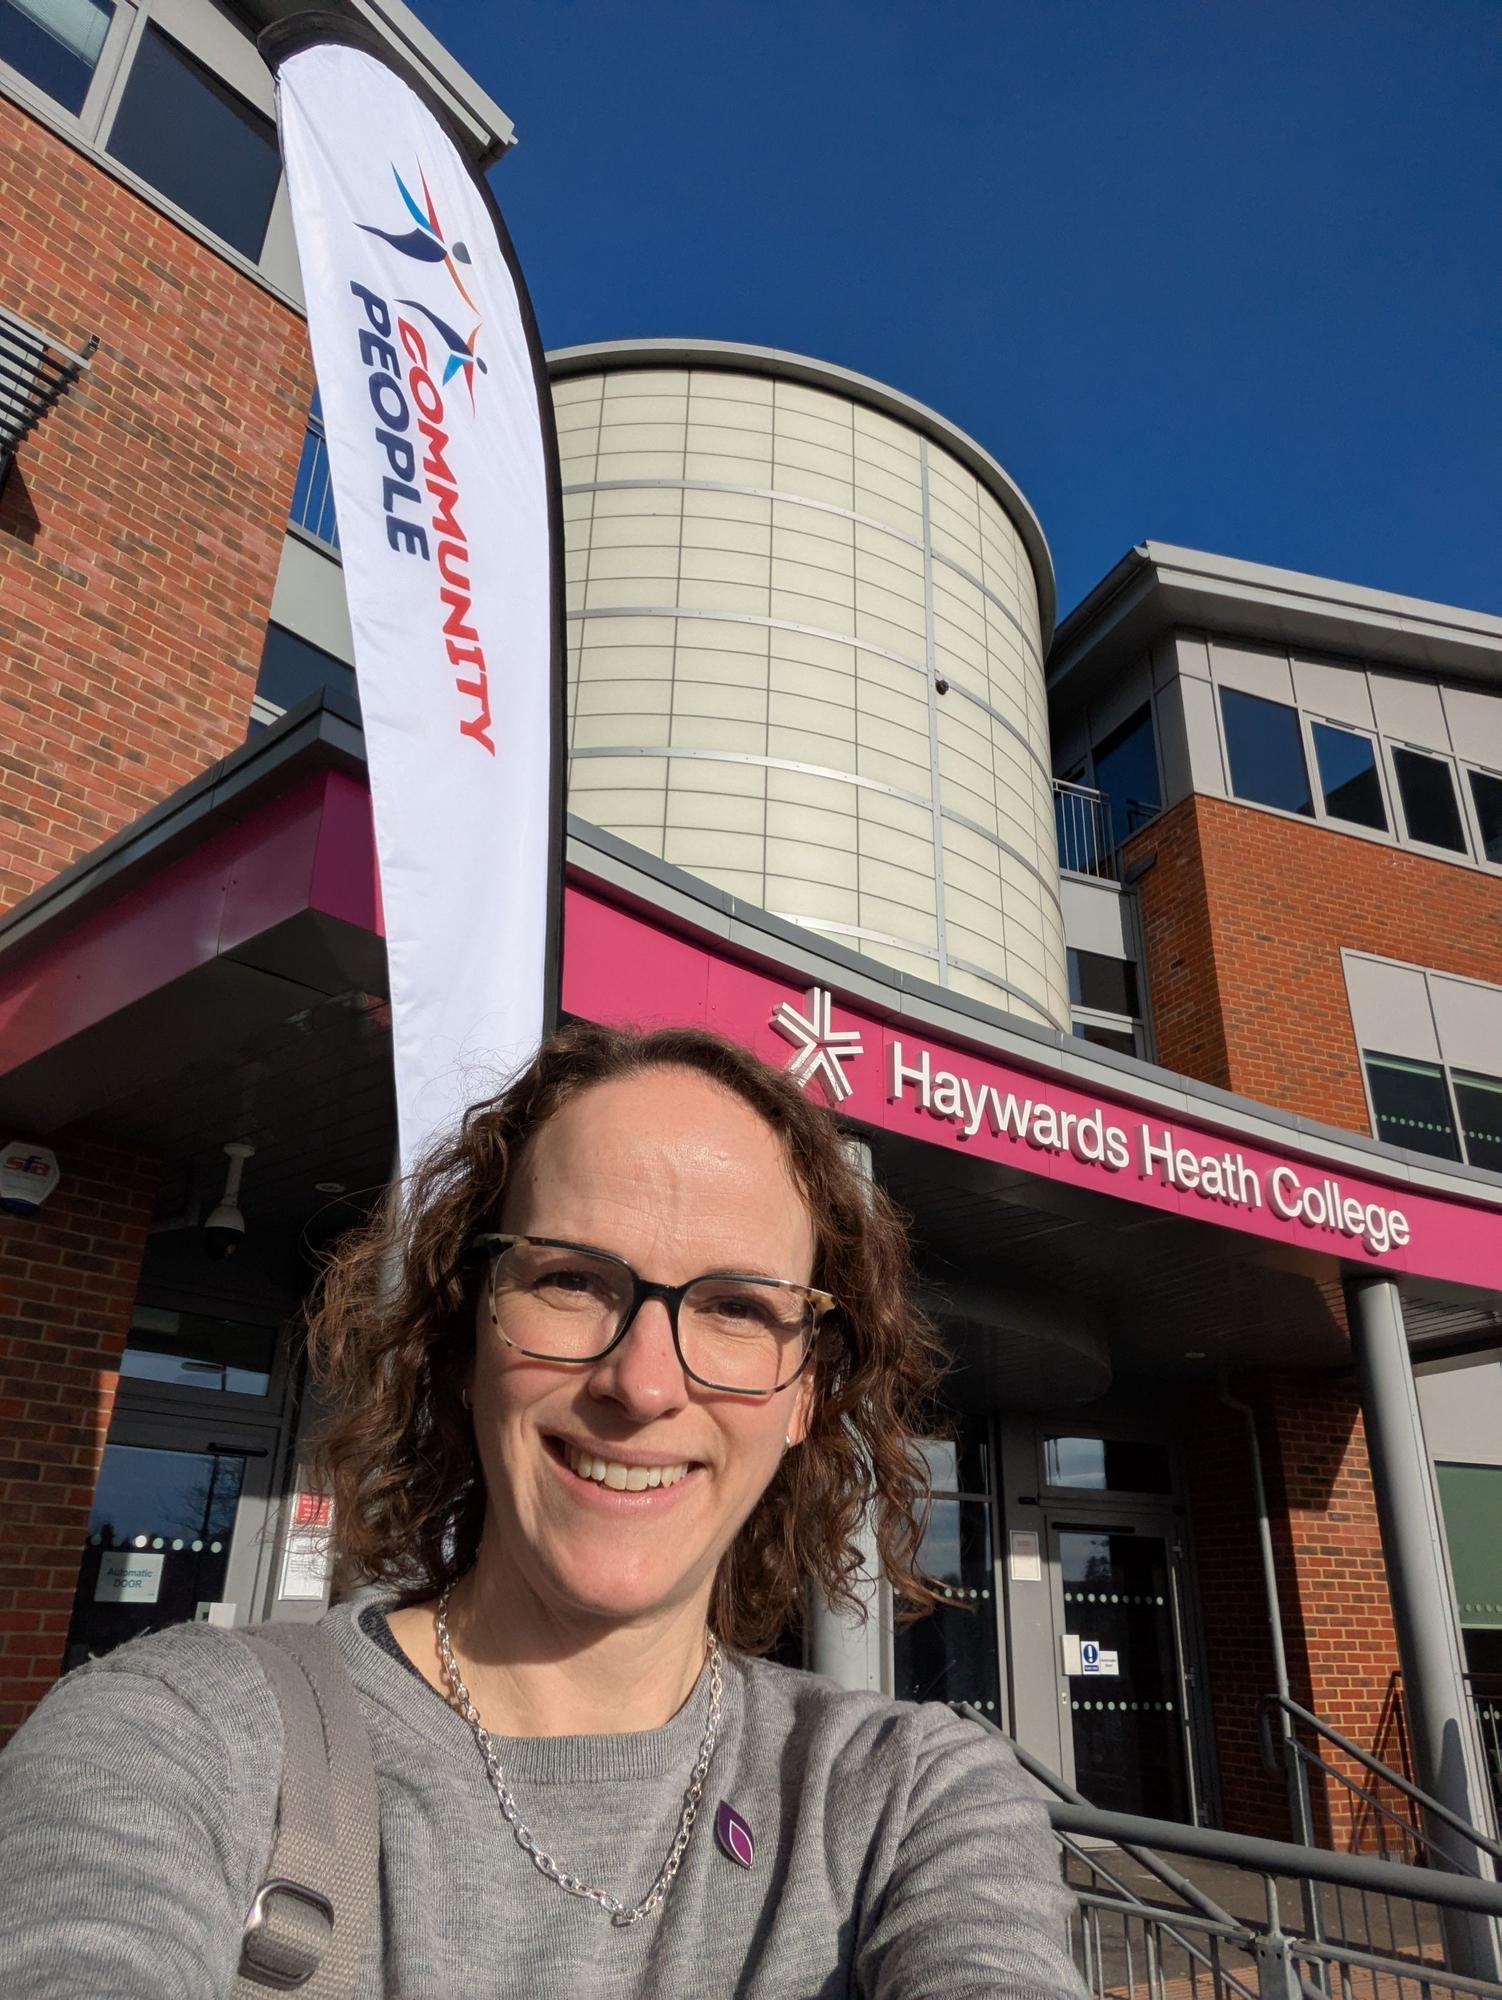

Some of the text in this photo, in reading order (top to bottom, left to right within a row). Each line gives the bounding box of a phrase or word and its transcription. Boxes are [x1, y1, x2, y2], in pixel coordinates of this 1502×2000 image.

[350, 281, 431, 562] PEOPLE
[397, 316, 496, 758] COMMUNITY
[887, 1041, 1412, 1253] Haywards Heath College
[107, 1568, 153, 1578] Automatic
[113, 1579, 143, 1588] DOOR
